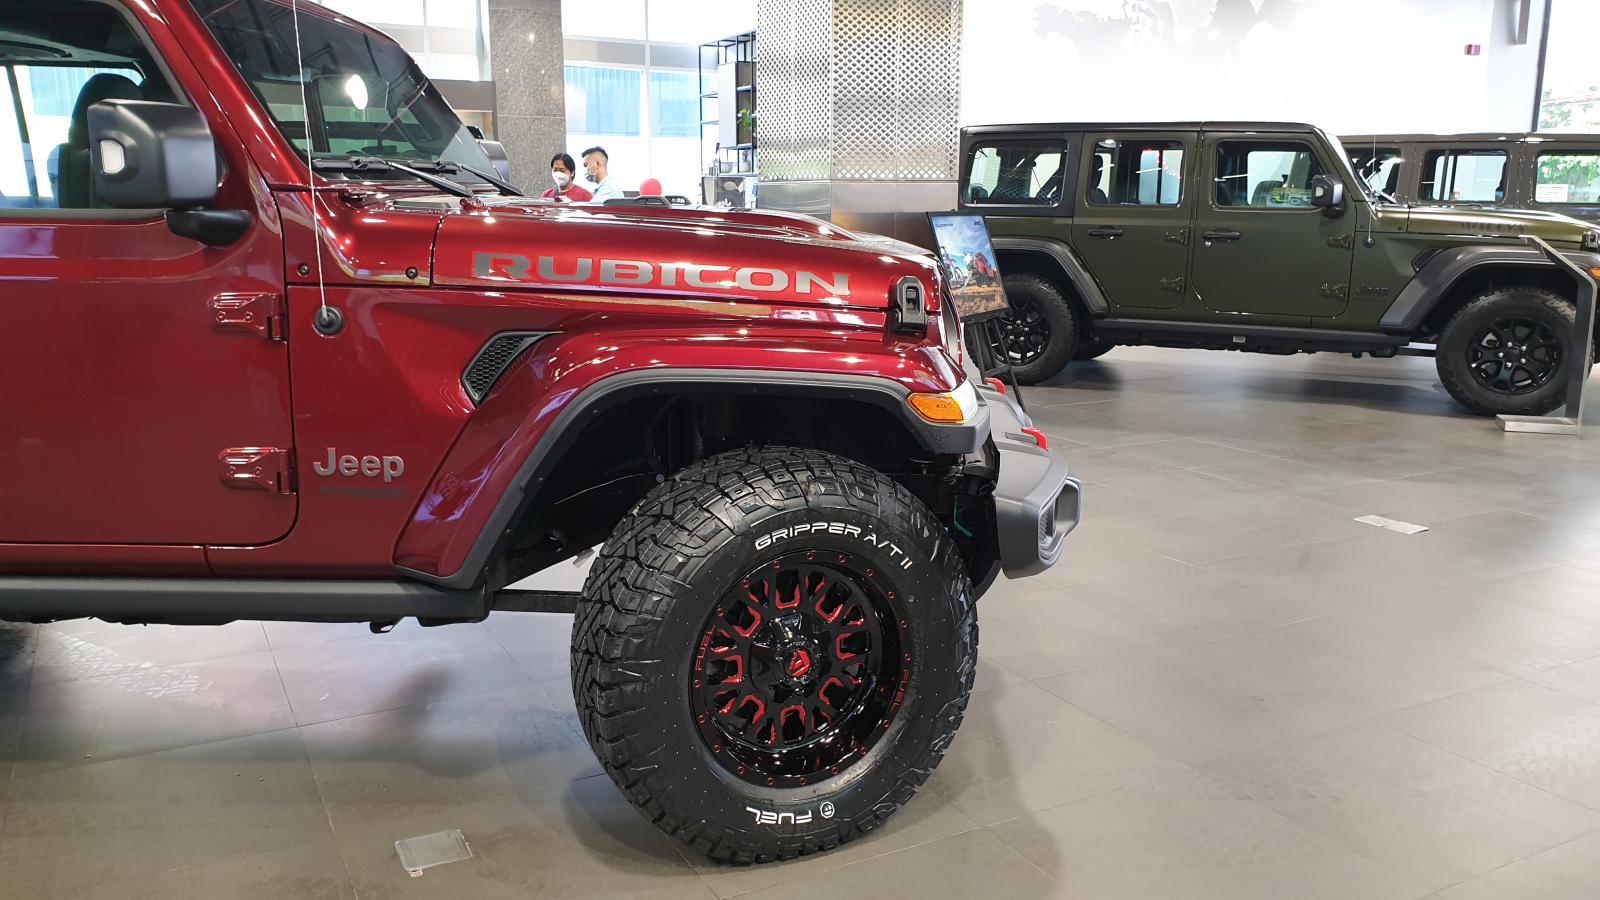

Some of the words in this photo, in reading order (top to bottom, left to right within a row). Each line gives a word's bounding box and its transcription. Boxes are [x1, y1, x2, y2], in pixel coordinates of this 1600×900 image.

[471, 252, 850, 296] RUBICON
[312, 447, 405, 482] Jeep
[754, 521, 862, 551] GRIPPER
[863, 532, 903, 557] A/T
[695, 624, 716, 671] FUEL
[891, 668, 910, 711] FUEL
[745, 806, 813, 825] FUEL
